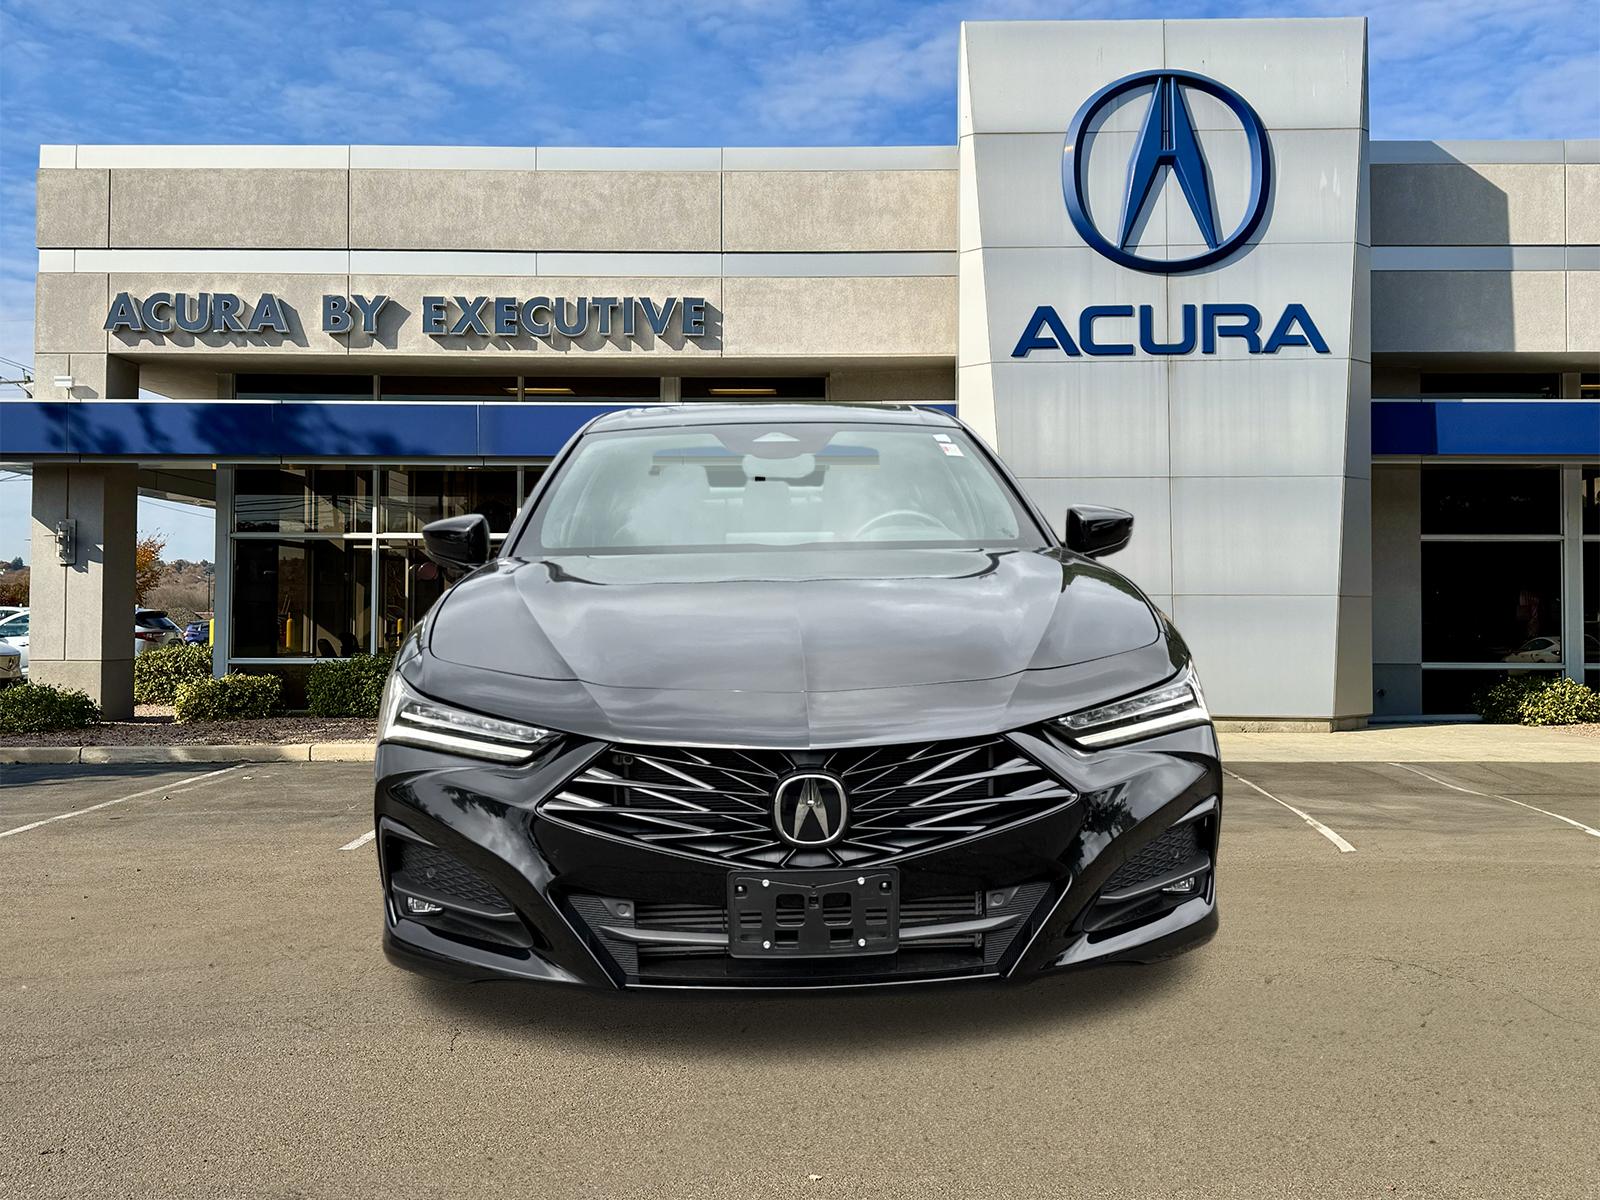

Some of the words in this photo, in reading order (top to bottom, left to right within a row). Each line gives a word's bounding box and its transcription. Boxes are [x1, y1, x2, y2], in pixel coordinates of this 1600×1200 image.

[104, 292, 288, 333] ACURA
[322, 294, 390, 335] BY
[422, 296, 706, 336] EXECUTIVE
[1011, 303, 1332, 357] ACURA
